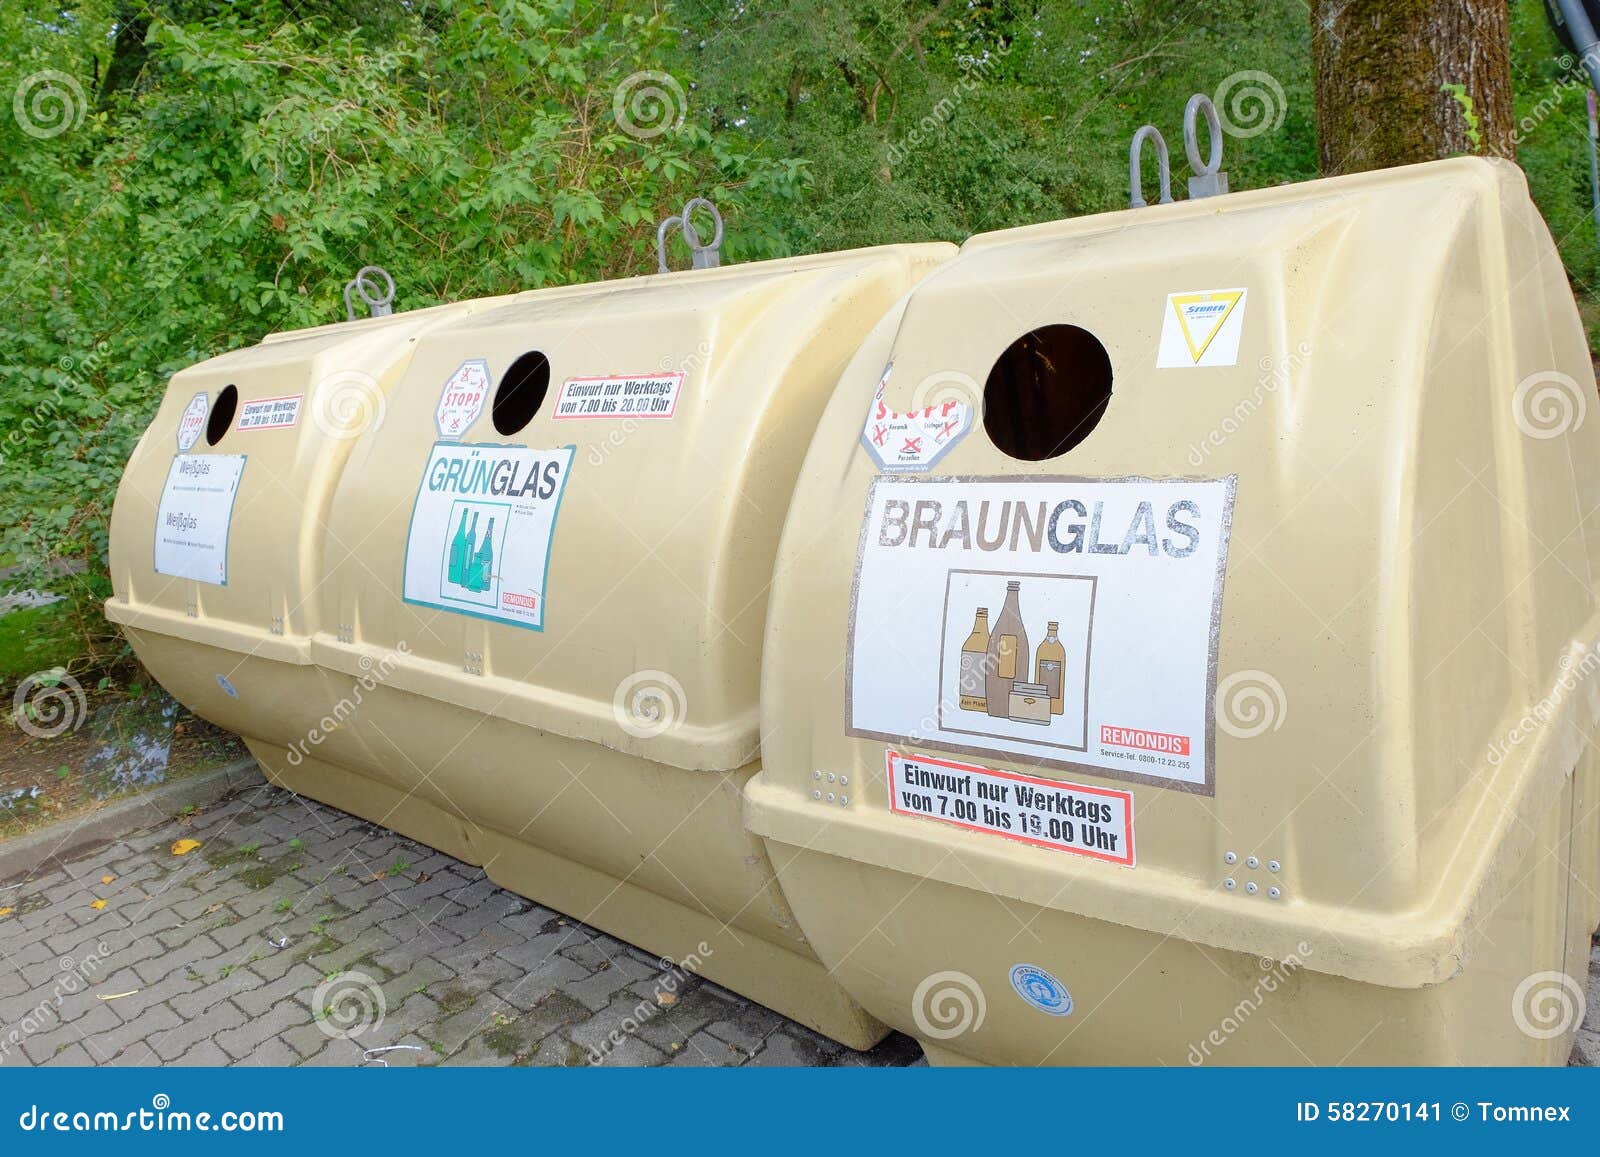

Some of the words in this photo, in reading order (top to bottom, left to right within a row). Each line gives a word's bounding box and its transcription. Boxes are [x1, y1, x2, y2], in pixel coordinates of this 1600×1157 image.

[445, 393, 480, 406] STOPP
[567, 383, 604, 397] Einwurf
[604, 384, 622, 396] nur
[624, 381, 673, 396] Werktags
[560, 402, 577, 413] von
[579, 399, 601, 413] 7.00
[601, 399, 618, 412] bis
[620, 399, 650, 412] 20.00
[650, 398, 670, 411] Uhr
[428, 450, 560, 500] GRÜNGLAS
[878, 499, 1202, 558] BRAUNGLAS
[1102, 727, 1183, 753] REMONDIS
[1100, 749, 1136, 761] Service-Tel.
[1168, 759, 1176, 767] 23
[904, 763, 971, 795] Einwurf
[977, 781, 1009, 804] nur
[1013, 784, 1112, 824] Werktags
[902, 791, 933, 811] von
[937, 795, 977, 822] 7.00
[984, 804, 1012, 830] bis
[1018, 811, 1075, 844] 19.00
[1082, 823, 1118, 852] Uhr
